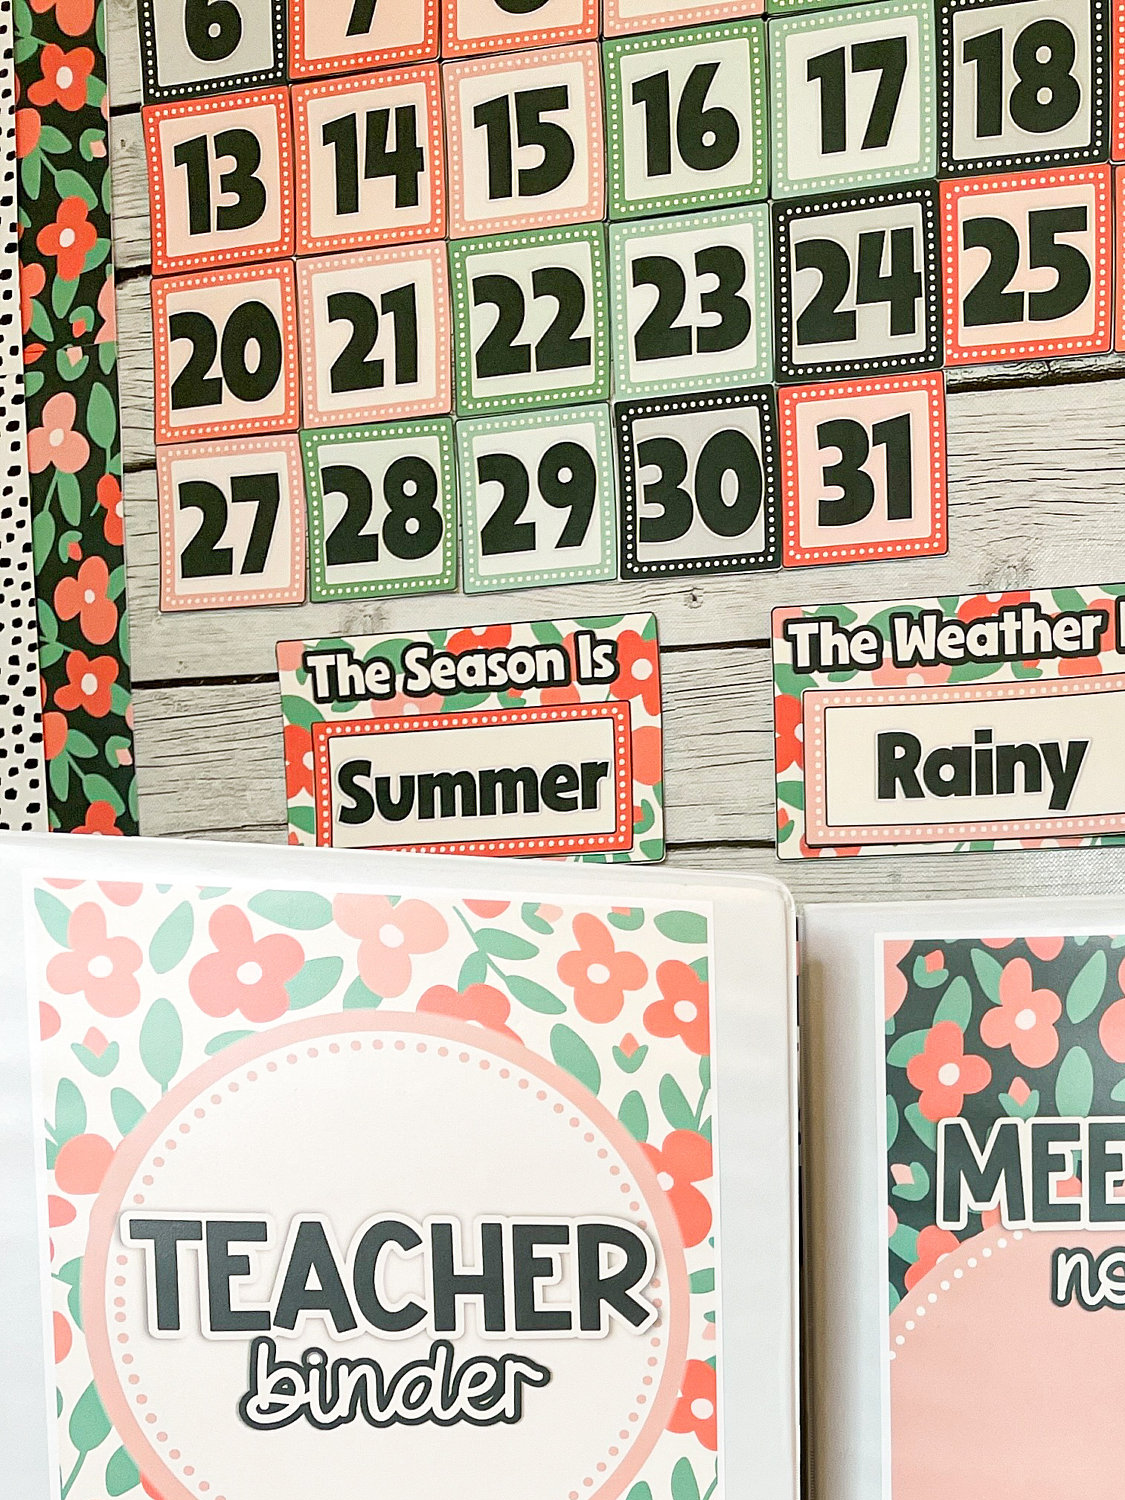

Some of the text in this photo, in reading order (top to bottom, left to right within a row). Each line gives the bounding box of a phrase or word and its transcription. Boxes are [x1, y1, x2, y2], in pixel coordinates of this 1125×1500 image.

[174, 129, 266, 235] 13
[323, 105, 424, 215] 14
[474, 85, 574, 199] 15
[632, 62, 739, 177] 16
[807, 36, 907, 154] 17
[963, 20, 1080, 137] 18
[169, 301, 282, 410] 20
[327, 283, 417, 393] 21
[472, 267, 591, 378] 22
[632, 246, 751, 361] 23
[795, 227, 922, 345] 24
[963, 206, 1091, 327] 25
[178, 414, 912, 578] 27 28 29 30 31
[306, 633, 617, 704] The Season Is
[787, 622, 878, 668] The
[894, 605, 1104, 660] Weather
[338, 760, 609, 824] Summer
[878, 729, 1089, 810] Rainy
[129, 1219, 649, 1333] TEACHER
[243, 1339, 547, 1426] binder
